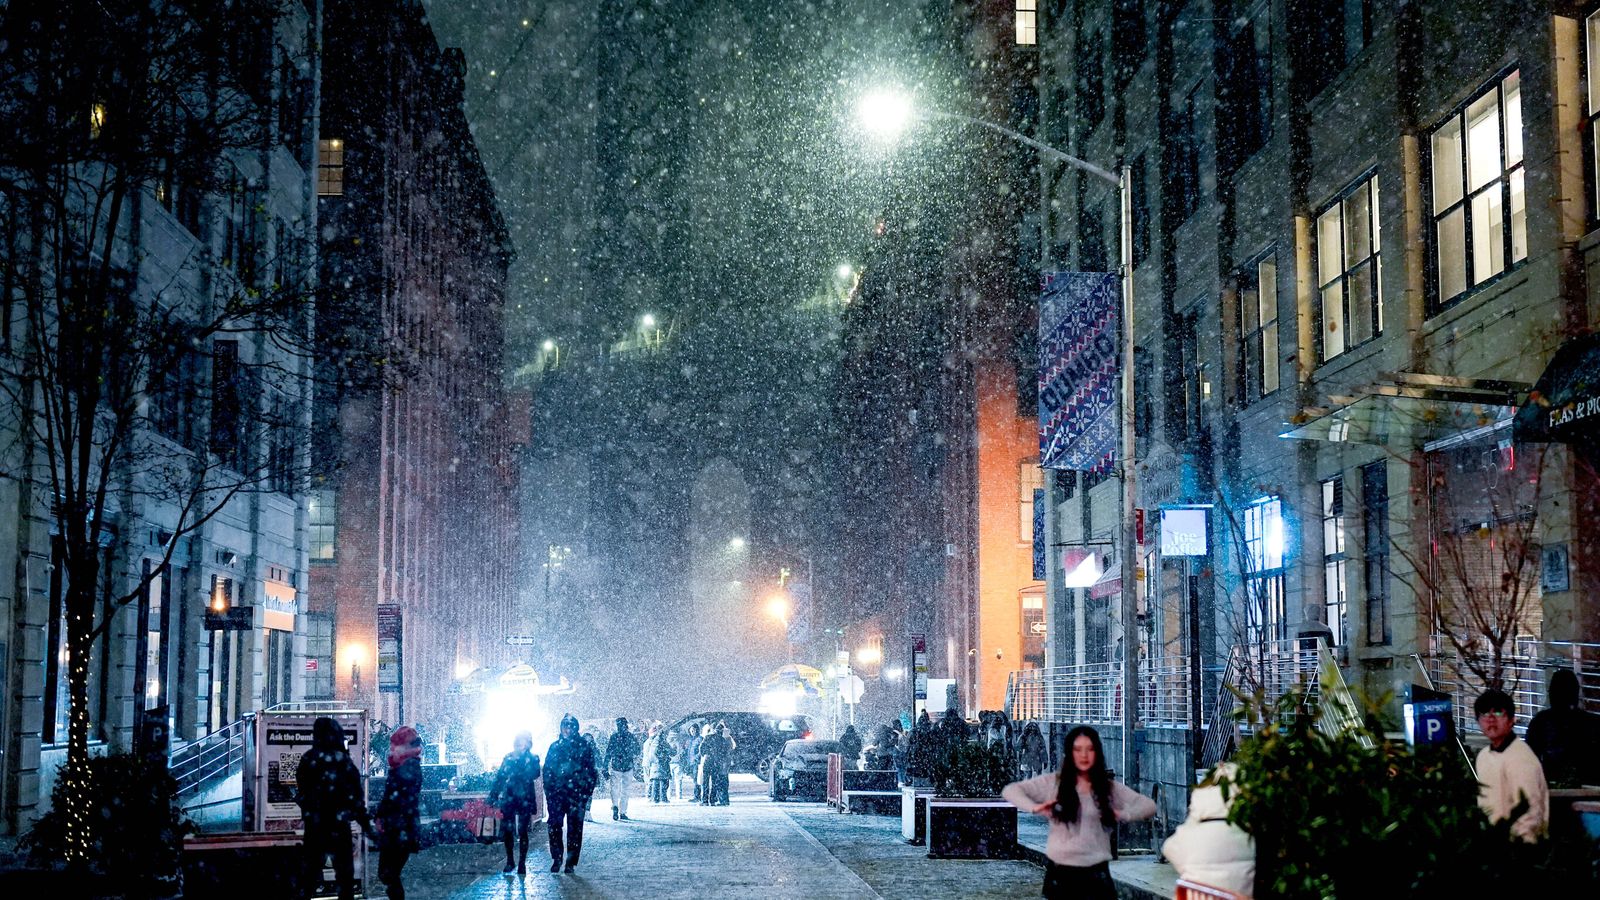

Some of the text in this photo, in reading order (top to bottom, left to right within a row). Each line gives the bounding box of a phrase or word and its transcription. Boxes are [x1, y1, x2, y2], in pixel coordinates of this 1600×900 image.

[1041, 333, 1114, 412] DUMBO
[1576, 402, 1585, 419] &
[153, 727, 162, 742] P
[269, 733, 283, 741] Ask
[284, 733, 294, 741] the
[1427, 719, 1441, 740] P
